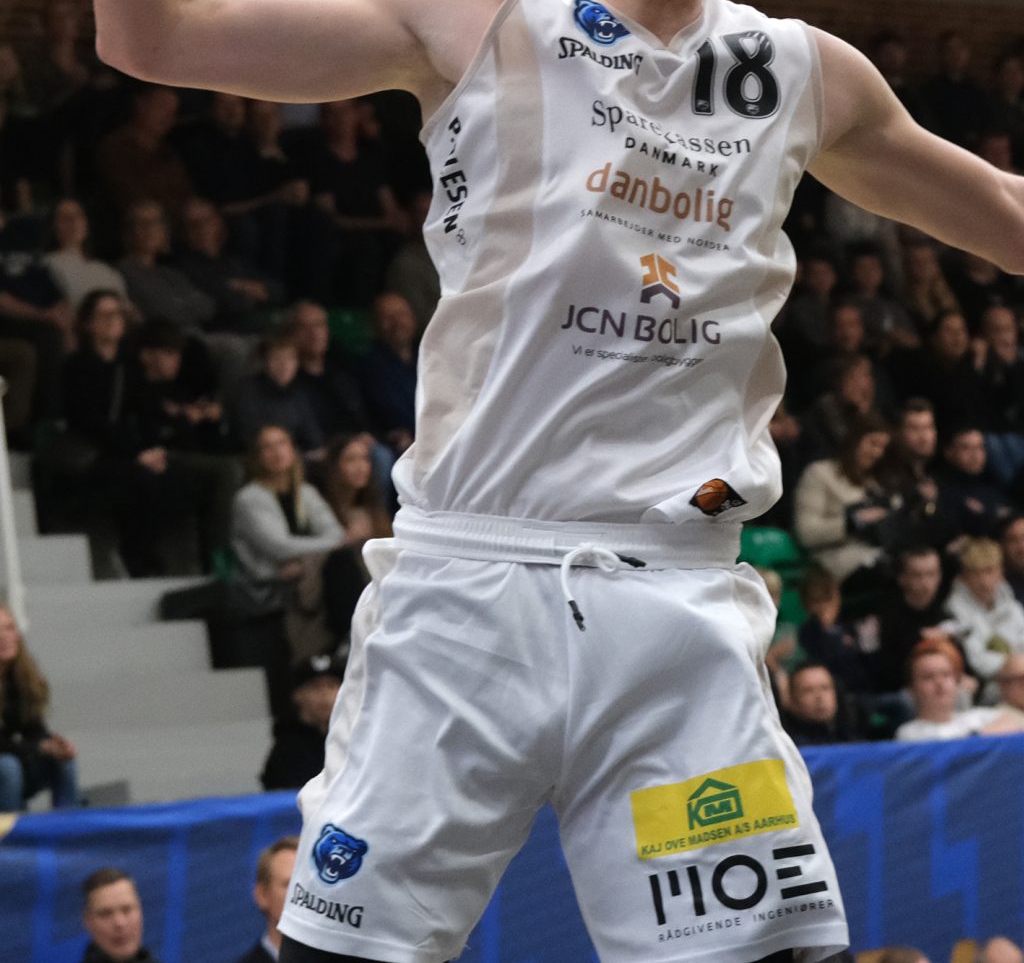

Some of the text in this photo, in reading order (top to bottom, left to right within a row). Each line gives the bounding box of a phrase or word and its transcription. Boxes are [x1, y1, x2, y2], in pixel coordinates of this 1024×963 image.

[557, 36, 643, 76] SPALDING
[691, 30, 781, 120] 18
[624, 137, 719, 178] DANMARK
[585, 162, 734, 232] danbolig
[580, 208, 730, 252] SAMARBEJDER MED NORDEA
[561, 304, 721, 345] JCN BOLIG
[641, 813, 796, 856] KAJ OVE MADSEN A/S AARHUS
[291, 882, 364, 928] SPALDING
[649, 844, 828, 926] MOE
[658, 899, 834, 942] RÅDGIVENDE INGENIØRER
